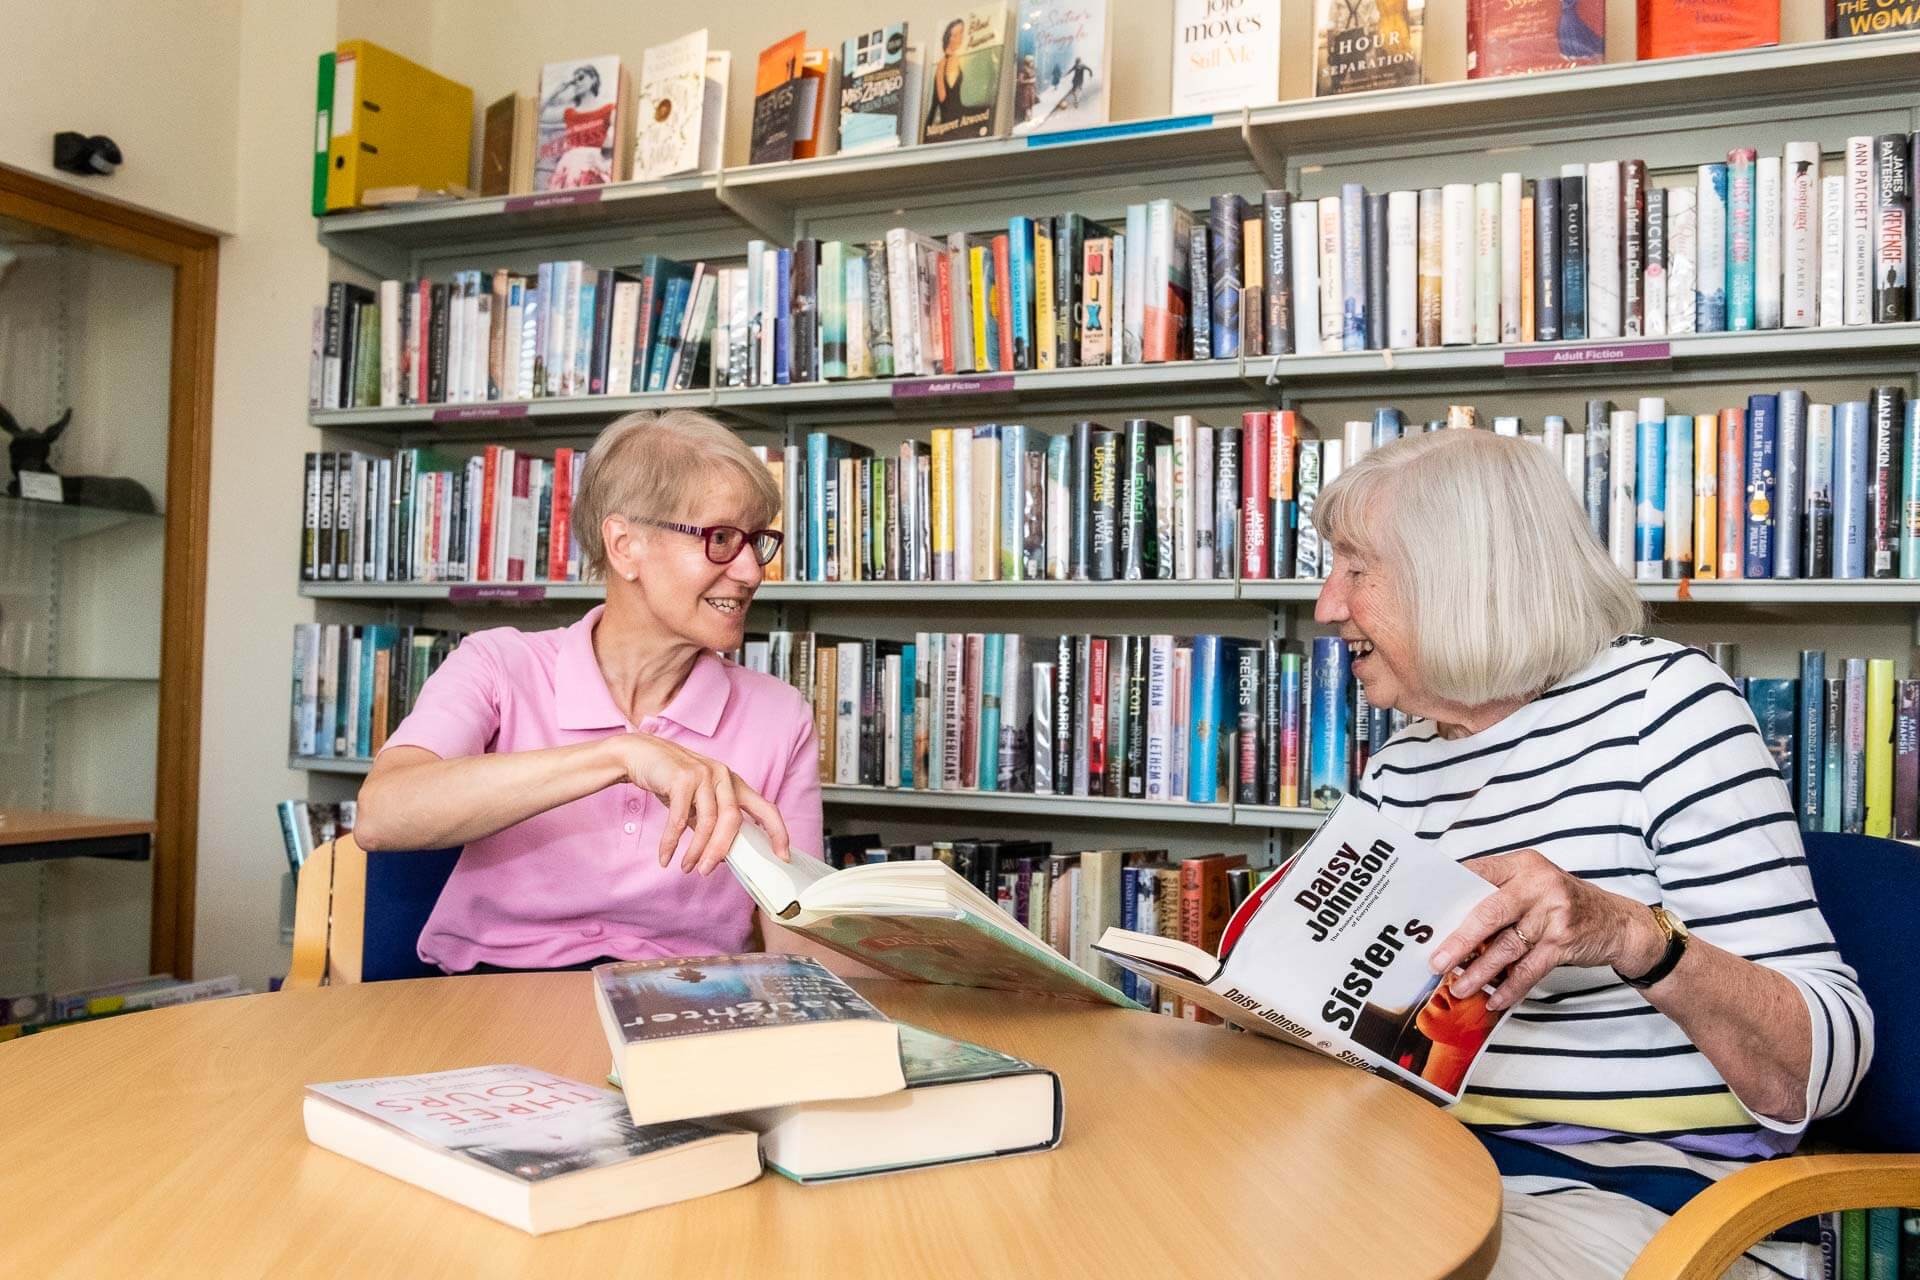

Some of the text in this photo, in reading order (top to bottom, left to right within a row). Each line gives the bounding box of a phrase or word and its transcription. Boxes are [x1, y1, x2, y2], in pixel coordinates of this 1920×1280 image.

[1837, 1, 1869, 15] THE
[1184, 15, 1262, 43] moyes
[1339, 31, 1401, 55] HOUR
[1321, 51, 1415, 77] SEPARATION
[1881, 141, 1893, 207] PATTERSON
[1894, 155, 1903, 192] JAMES
[1270, 204, 1286, 275] jojo moyes
[1567, 203, 1579, 255] ROOMS
[1648, 203, 1661, 260] LUCKY
[1855, 142, 1868, 305] ANN PATCHETT COMMONWEALTH
[1882, 209, 1904, 264] REVENGE
[1796, 258, 1805, 299] PARRIS
[1015, 301, 1023, 336] HOUSE
[1553, 350, 1624, 361] Adult Fiction
[928, 382, 981, 391] Adult Fiction
[1879, 395, 1891, 417] IAN
[1270, 416, 1280, 491] PATTERSON
[1281, 433, 1290, 474] JAMES
[1752, 409, 1766, 486] BEDLAM STACKS
[1764, 440, 1773, 454] THE
[1816, 442, 1826, 463] Knew
[1879, 419, 1890, 468] RANKIN
[1093, 446, 1105, 502] UPSTAIRS
[1104, 439, 1116, 508] THE FAMILY
[1134, 432, 1145, 524] LISA JEWELL
[1220, 441, 1237, 499] hidden
[1093, 510, 1104, 554] JEWELL
[1103, 519, 1114, 545] LISA
[1121, 479, 1131, 551] INVISIBLE GIRL
[1245, 497, 1256, 561] PATTERSON
[1254, 511, 1264, 546] JAMES
[1749, 526, 1758, 557] PULLEY
[1758, 525, 1767, 559] NATASHA
[1058, 647, 1070, 680] JOHN
[1240, 656, 1252, 705] REICHS
[944, 686, 956, 720] OTHER
[1130, 677, 1145, 716] Leon
[1151, 648, 1164, 780] JONATHAN LETHEM
[1829, 690, 1838, 702] The
[1829, 704, 1838, 729] Comet
[1900, 715, 1909, 755] SHAMSIE
[1909, 718, 1917, 752] KAMILA
[944, 722, 957, 782] AMERICANS
[1294, 842, 1361, 912] Daisy
[1305, 838, 1395, 943] Johnson
[1168, 877, 1179, 918] SIGNAL
[1191, 899, 1199, 929] FIVE
[1330, 932, 1340, 942] The
[1222, 987, 1313, 1040] Daisy Johnson
[374, 1078, 577, 1113] HOURS
[427, 1091, 602, 1126] THREE
